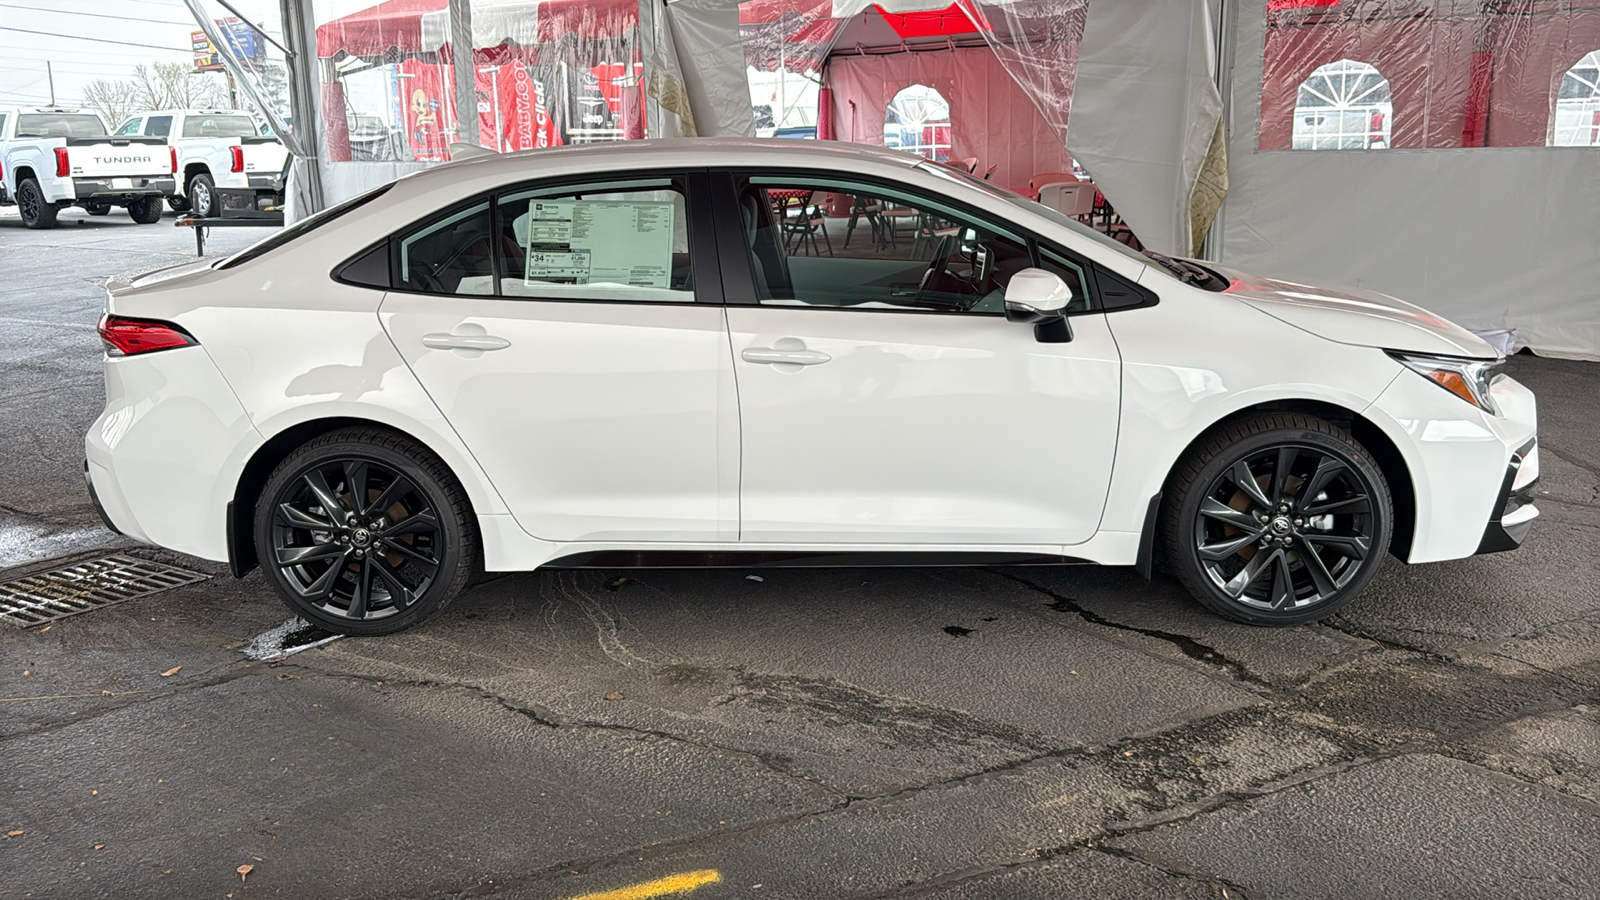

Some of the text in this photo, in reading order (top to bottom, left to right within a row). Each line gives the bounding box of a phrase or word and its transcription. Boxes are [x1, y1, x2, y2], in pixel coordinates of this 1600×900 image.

[534, 79, 548, 149] ck Click!
[583, 112, 603, 126] Jeep
[93, 156, 151, 164] TUNDRA
